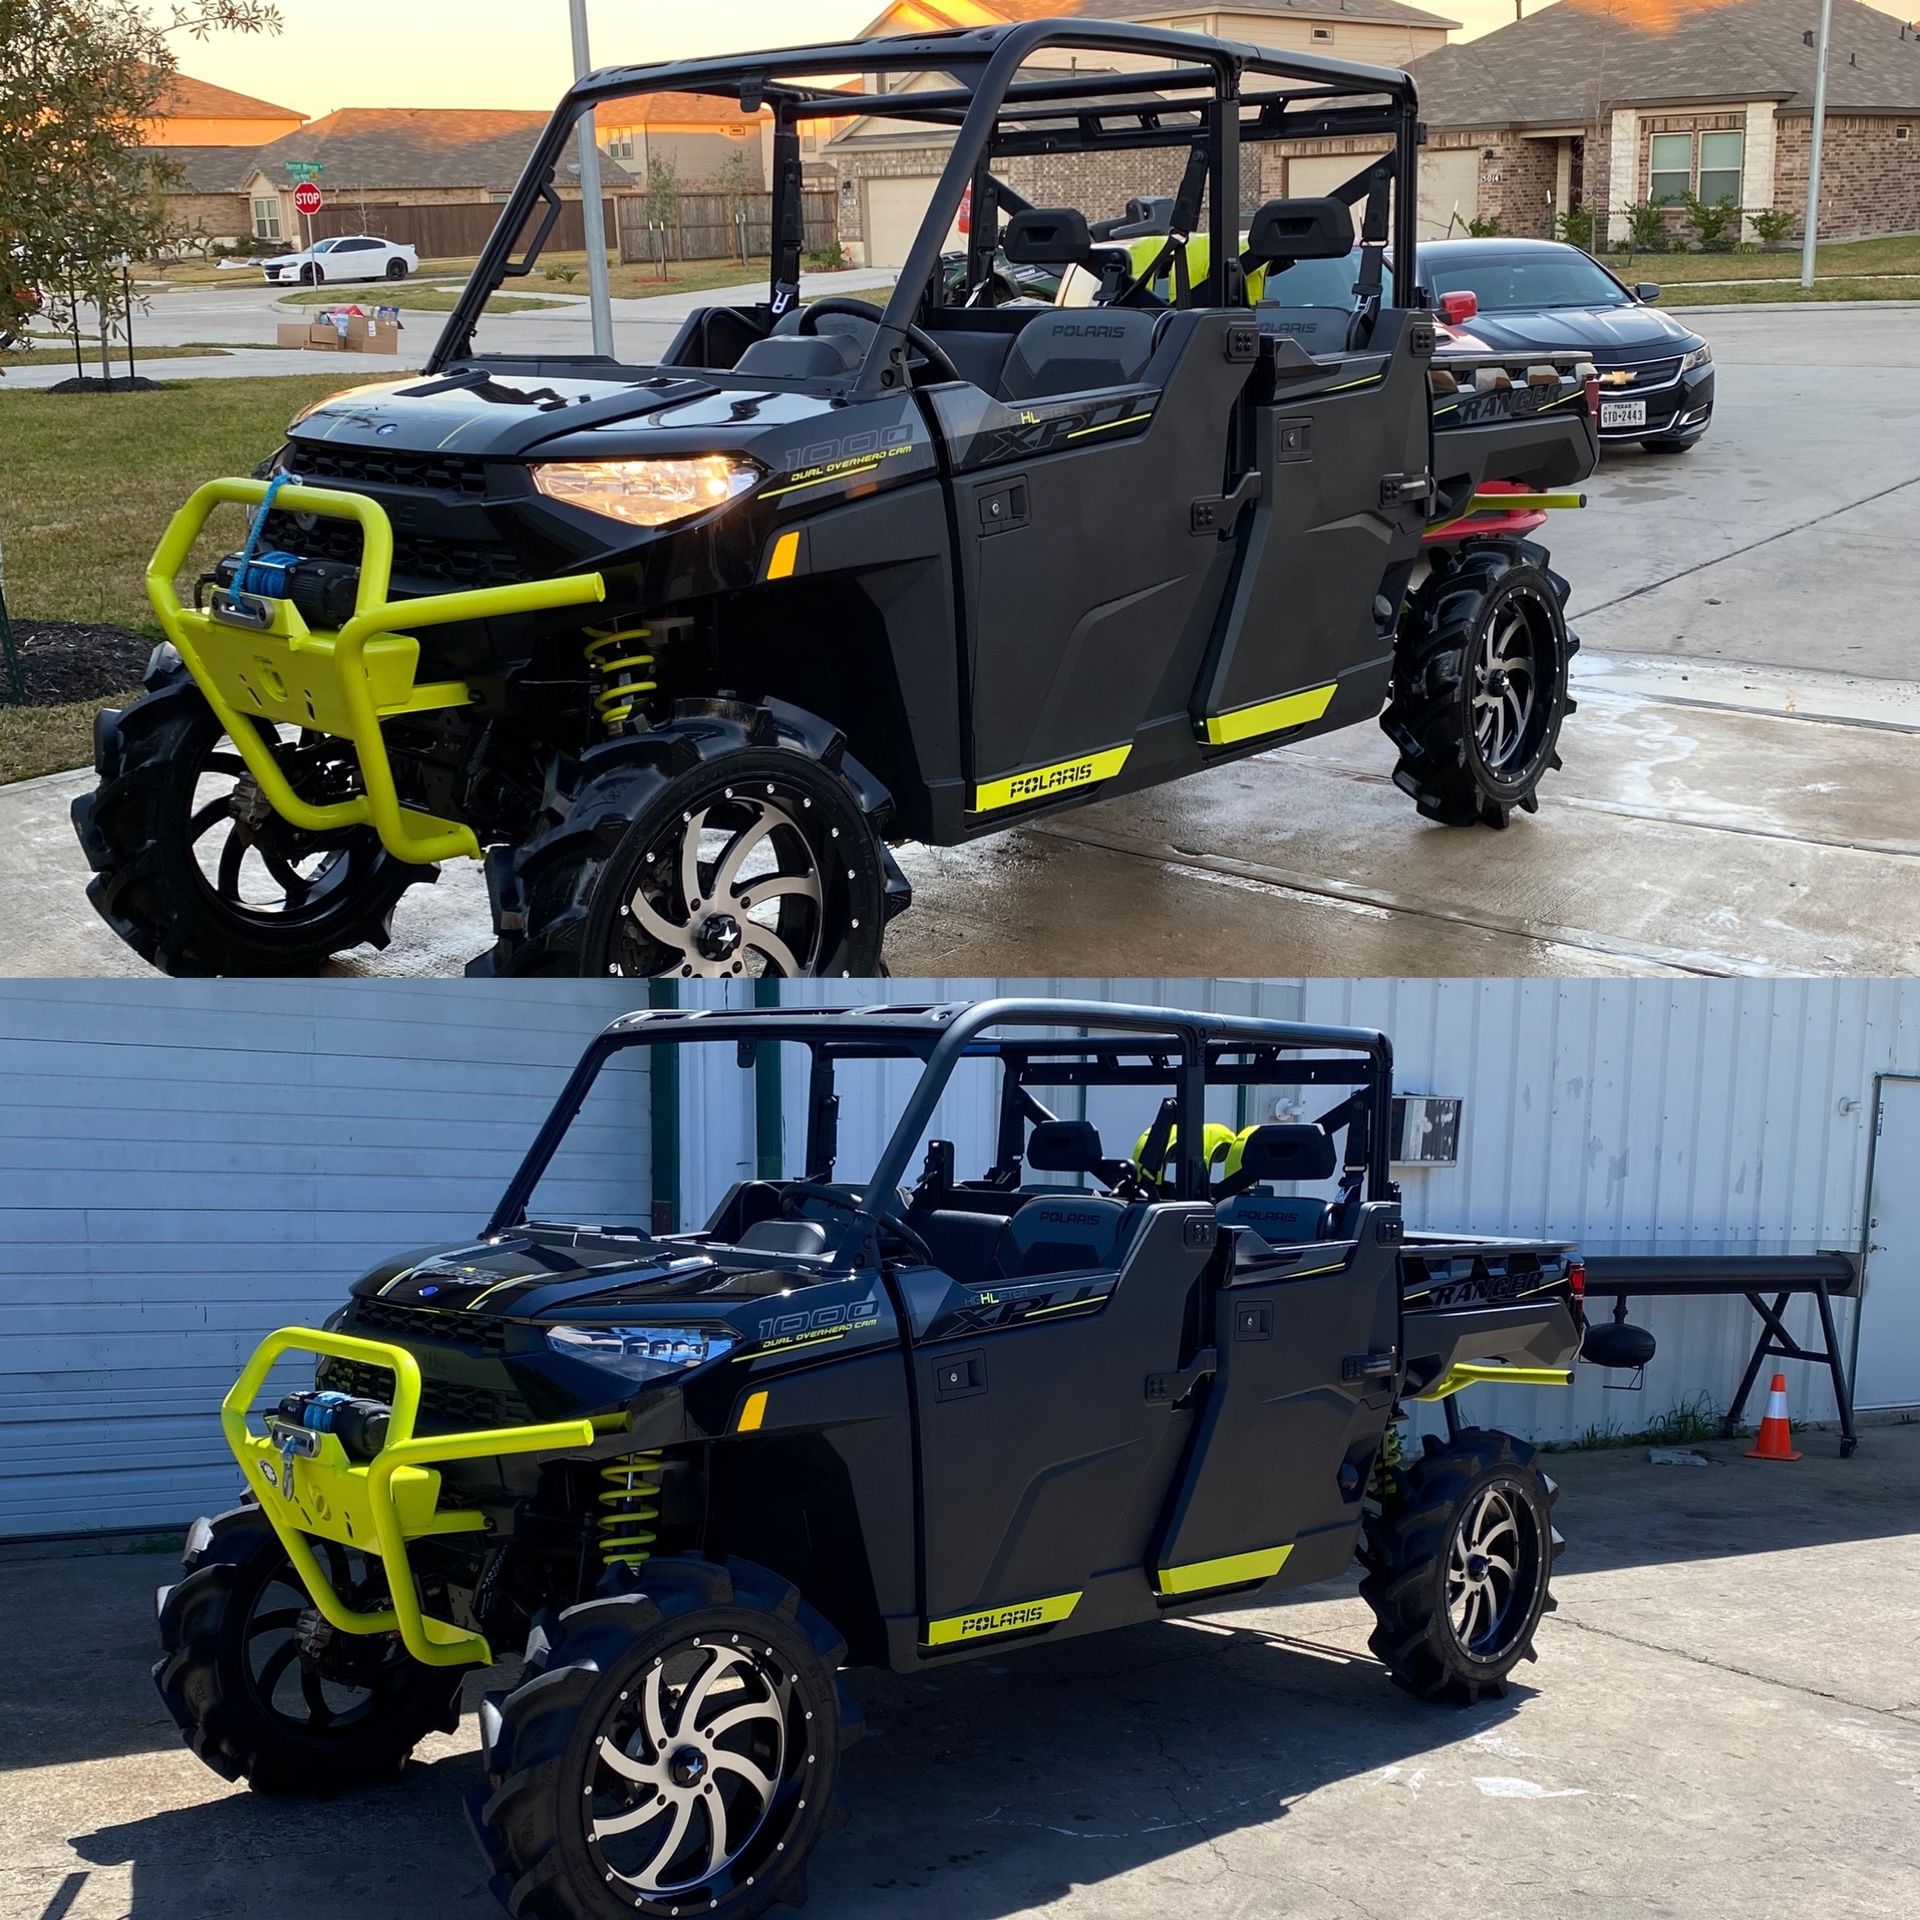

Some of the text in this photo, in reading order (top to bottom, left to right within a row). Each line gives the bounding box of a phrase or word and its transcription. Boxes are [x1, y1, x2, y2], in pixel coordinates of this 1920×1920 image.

[296, 193, 320, 205] STOP
[1051, 325, 1126, 338] POLARIS
[1259, 322, 1317, 334] OLARIS
[1460, 383, 1561, 422] RANGER
[785, 423, 914, 472] 1000
[790, 444, 913, 482] DUAL OVERHEAD CAM
[1009, 763, 1093, 798] POLARIS
[1039, 1211, 1101, 1225] POLARIS
[1236, 1209, 1298, 1222] POLARIS
[1433, 1271, 1544, 1308] RANGER
[758, 1300, 880, 1340] 1000
[763, 1319, 877, 1348] DUAL OVERHEAD CAM
[961, 1606, 1044, 1635] POLARIS
